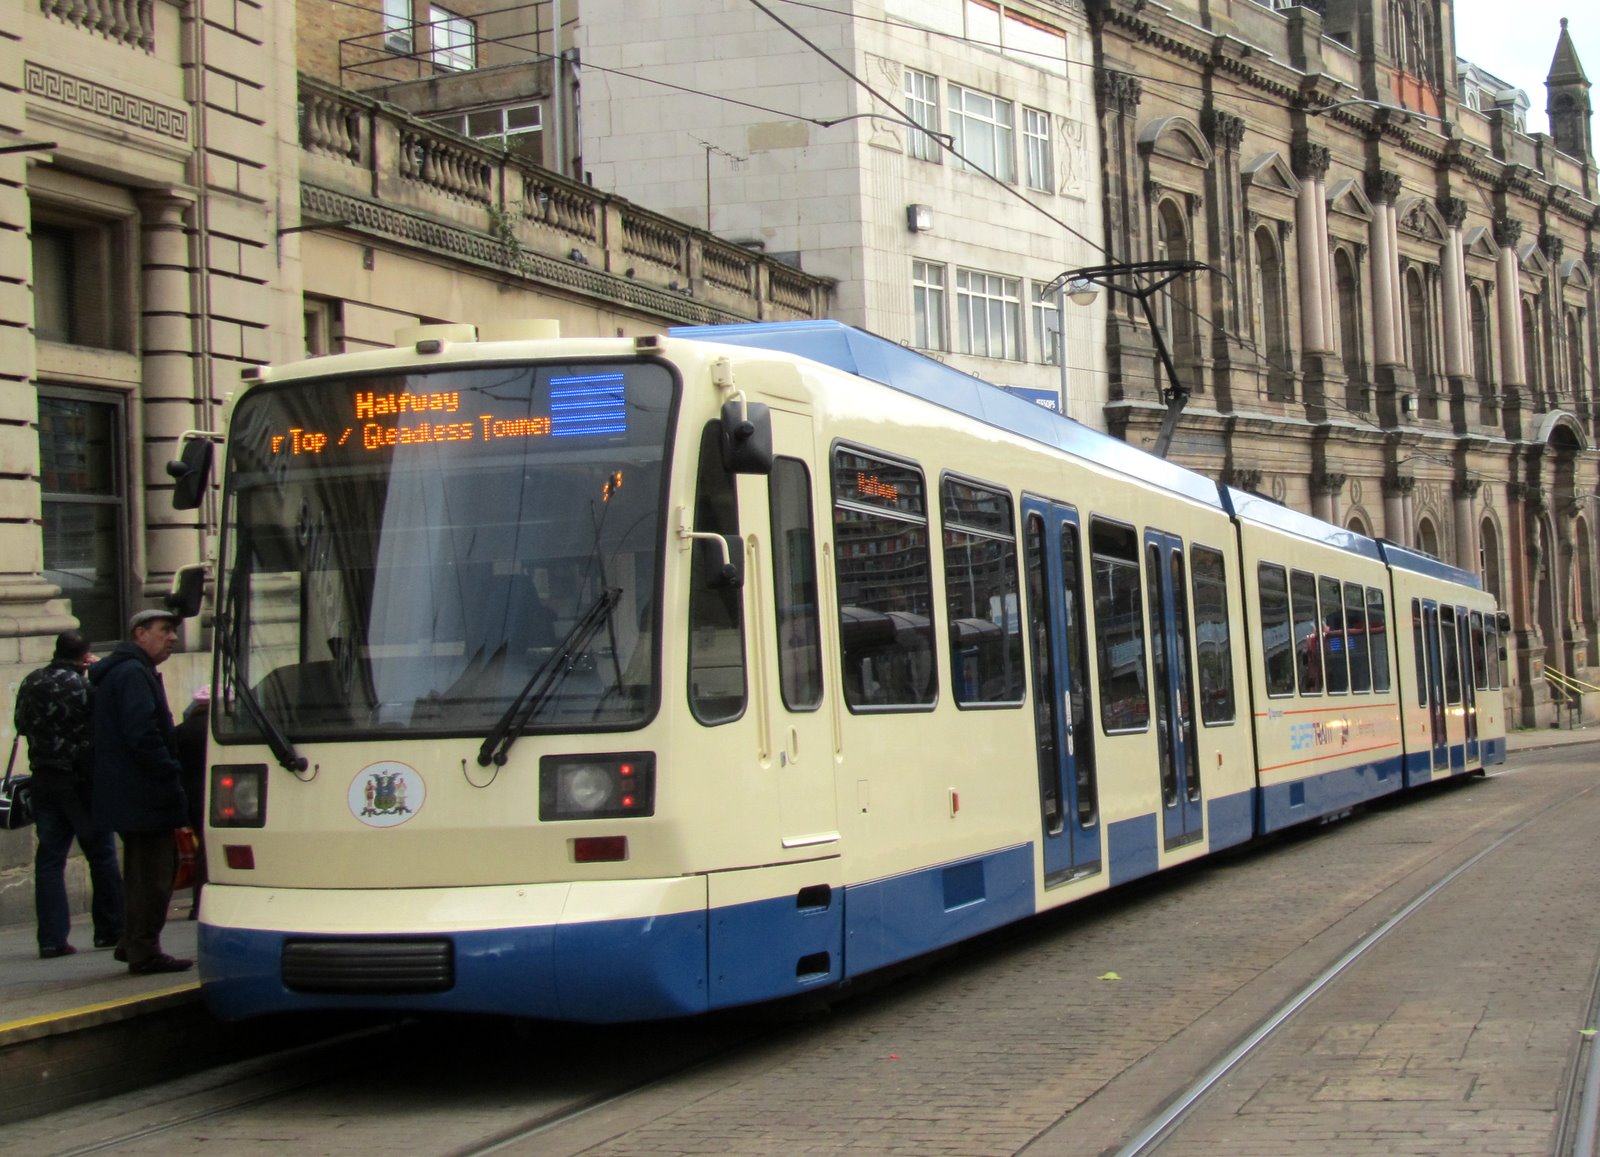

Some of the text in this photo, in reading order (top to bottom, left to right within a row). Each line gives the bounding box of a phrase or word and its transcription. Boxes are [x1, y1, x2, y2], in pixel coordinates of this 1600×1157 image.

[356, 391, 459, 418] Halfway
[289, 426, 327, 455] Top
[363, 422, 474, 450] Gleadless
